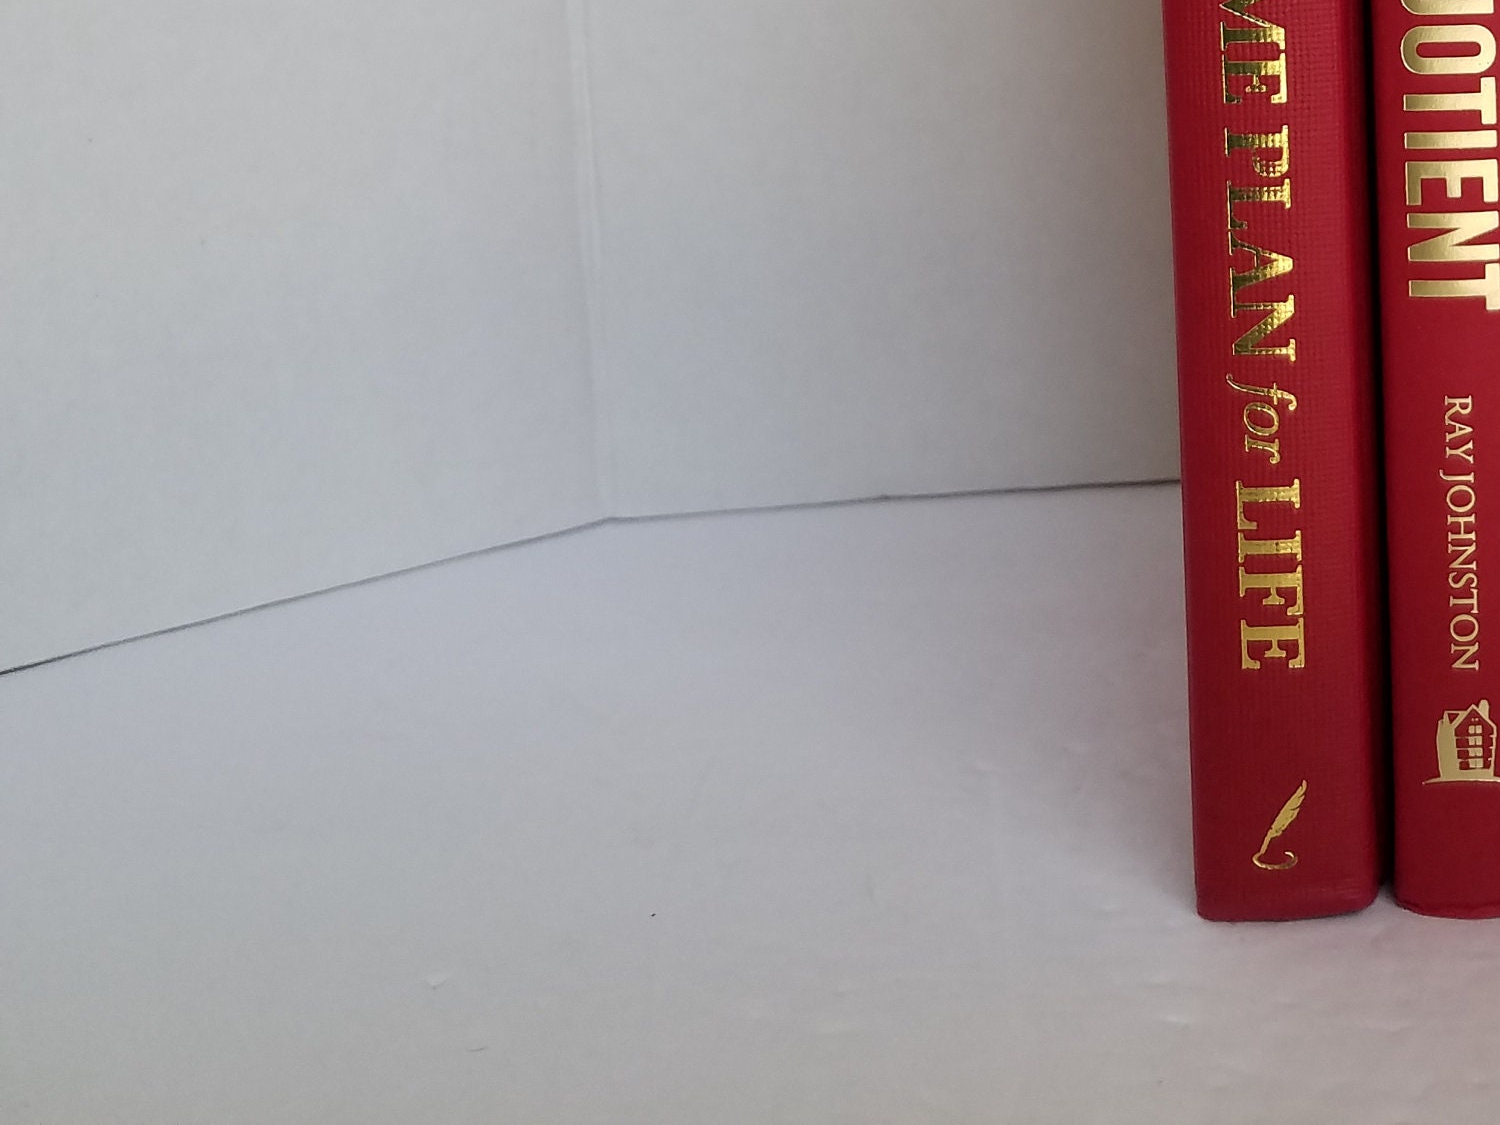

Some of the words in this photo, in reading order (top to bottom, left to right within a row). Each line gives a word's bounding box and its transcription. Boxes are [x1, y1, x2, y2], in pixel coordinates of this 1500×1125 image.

[1224, 124, 1297, 363] PLAN
[1225, 373, 1298, 465] for
[1444, 394, 1475, 464] RAY
[1235, 478, 1306, 670] LIFE
[1439, 469, 1480, 671] JOHNSTON
